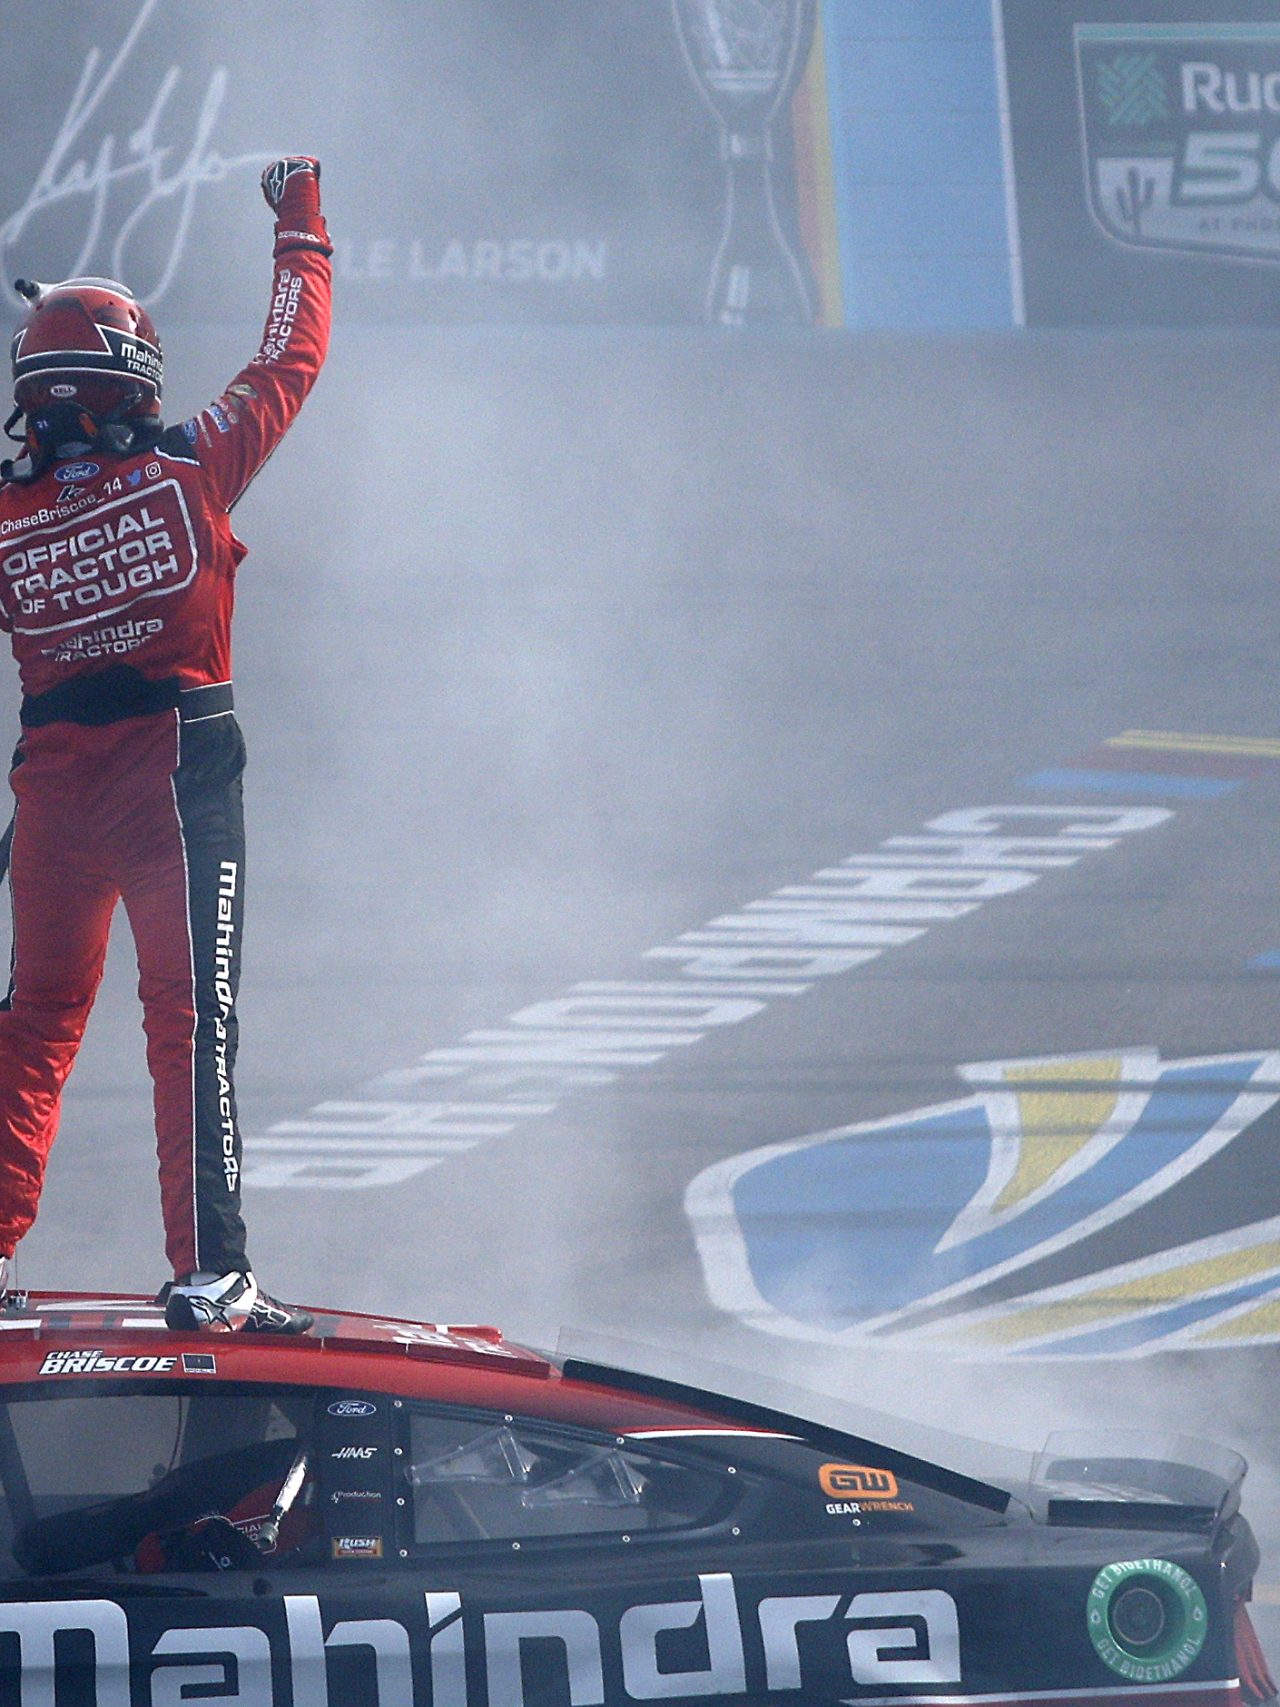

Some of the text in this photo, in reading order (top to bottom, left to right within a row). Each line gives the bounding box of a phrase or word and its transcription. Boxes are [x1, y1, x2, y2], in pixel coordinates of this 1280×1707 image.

[338, 239, 608, 279] LE LARSON
[2, 507, 165, 577] OFFICIAL
[11, 530, 173, 600] TRACTOR
[22, 554, 179, 614] OF TOUGH
[58, 618, 164, 650] ahindra
[39, 1356, 177, 1375] BRISCOE
[46, 1350, 103, 1360] CHASE
